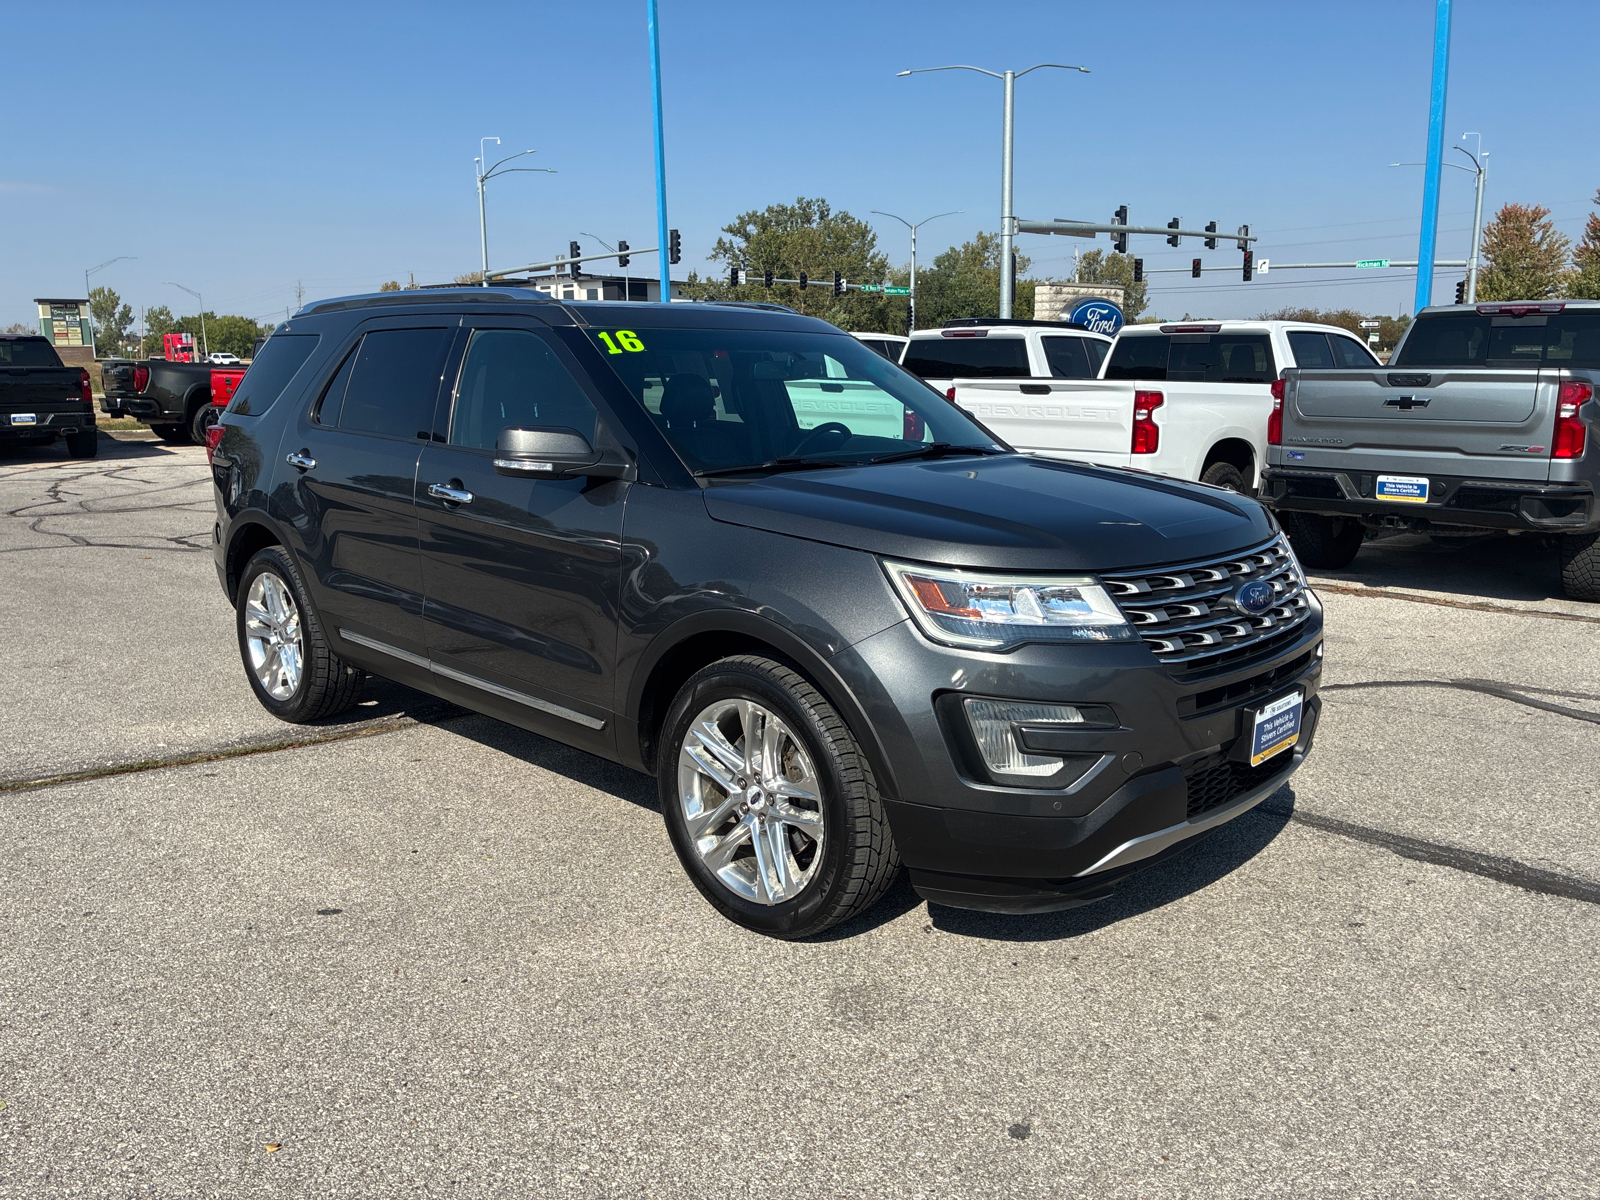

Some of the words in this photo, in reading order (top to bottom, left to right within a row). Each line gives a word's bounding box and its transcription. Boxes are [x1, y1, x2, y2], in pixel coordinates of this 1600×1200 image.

[1084, 307, 1117, 333] Ford
[598, 330, 645, 354] 16
[792, 400, 892, 413] HEVROLET
[1288, 436, 1344, 444] SILVERADO
[1249, 586, 1271, 606] Ford
[1261, 731, 1276, 744] Stivers
[1277, 718, 1295, 735] Certified
[1264, 721, 1273, 732] This
[1274, 713, 1289, 727] Vehicle
[1289, 711, 1293, 719] is
